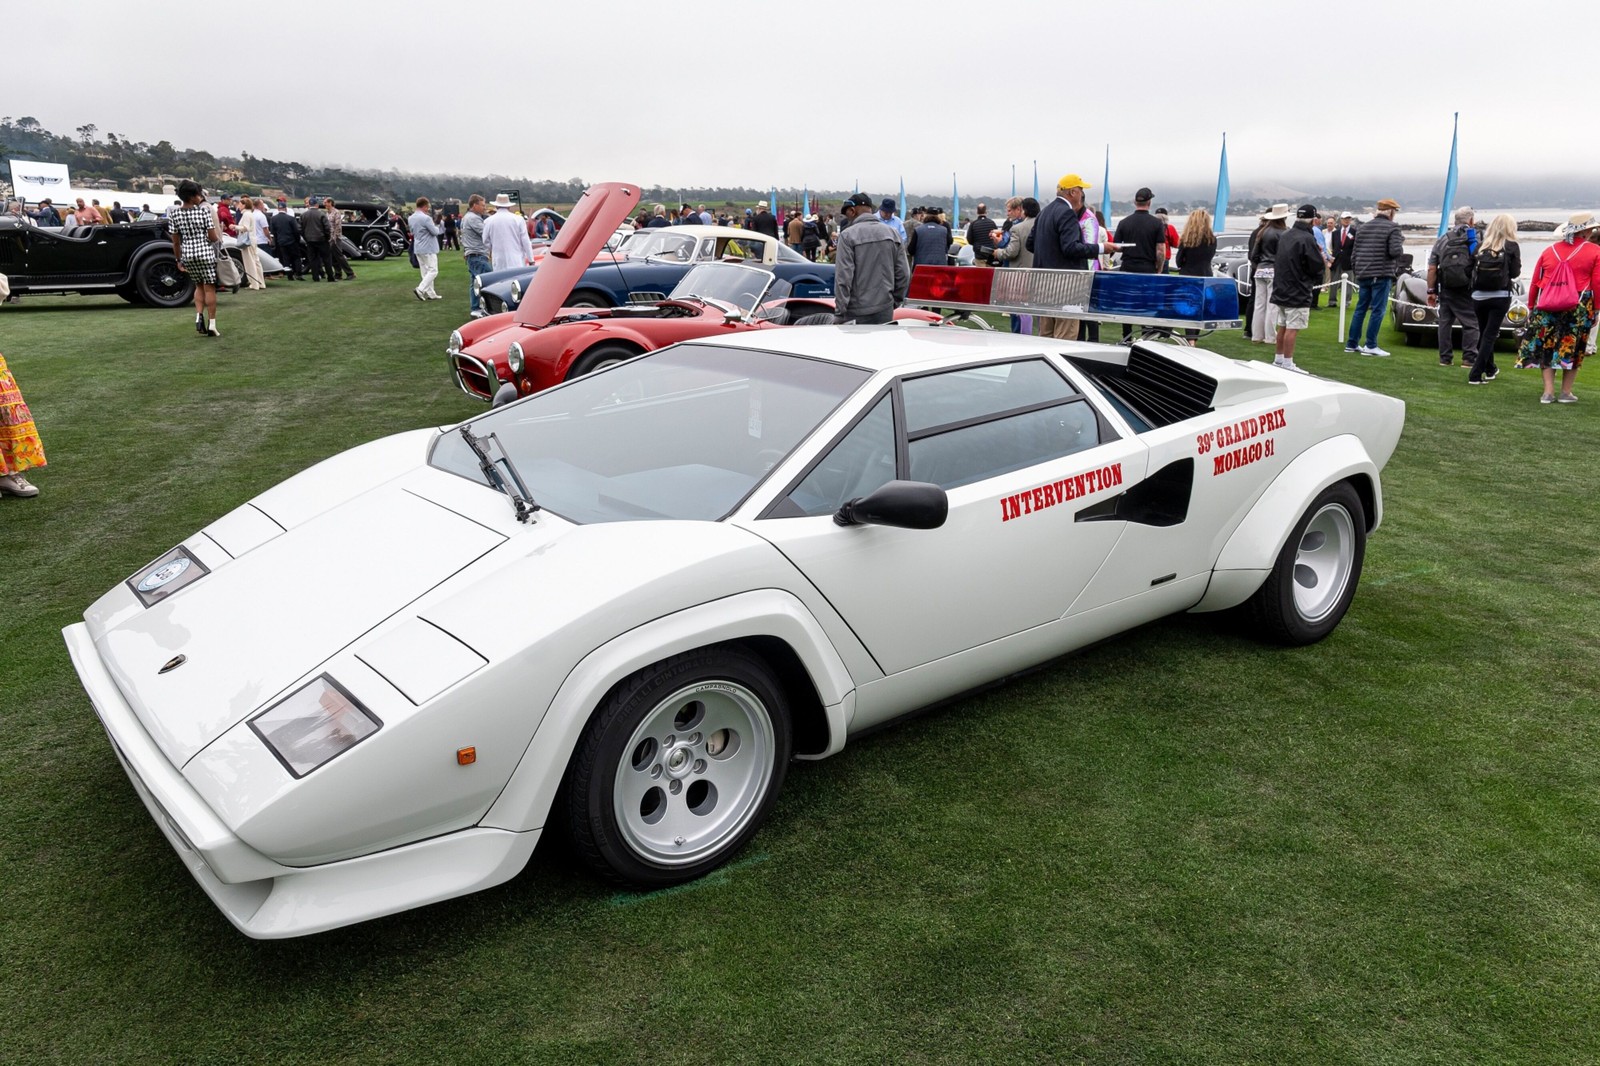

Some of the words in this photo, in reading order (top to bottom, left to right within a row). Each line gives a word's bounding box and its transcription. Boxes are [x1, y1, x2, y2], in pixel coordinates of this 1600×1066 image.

[1216, 418, 1258, 448] GRAND
[1258, 408, 1287, 434] PRIX
[1213, 442, 1263, 476] MONACO
[1264, 438, 1275, 458] 81
[1000, 462, 1123, 522] INTERVENTION
[616, 685, 653, 723] PIRELLI
[695, 684, 737, 694] CAMPAGNOLO
